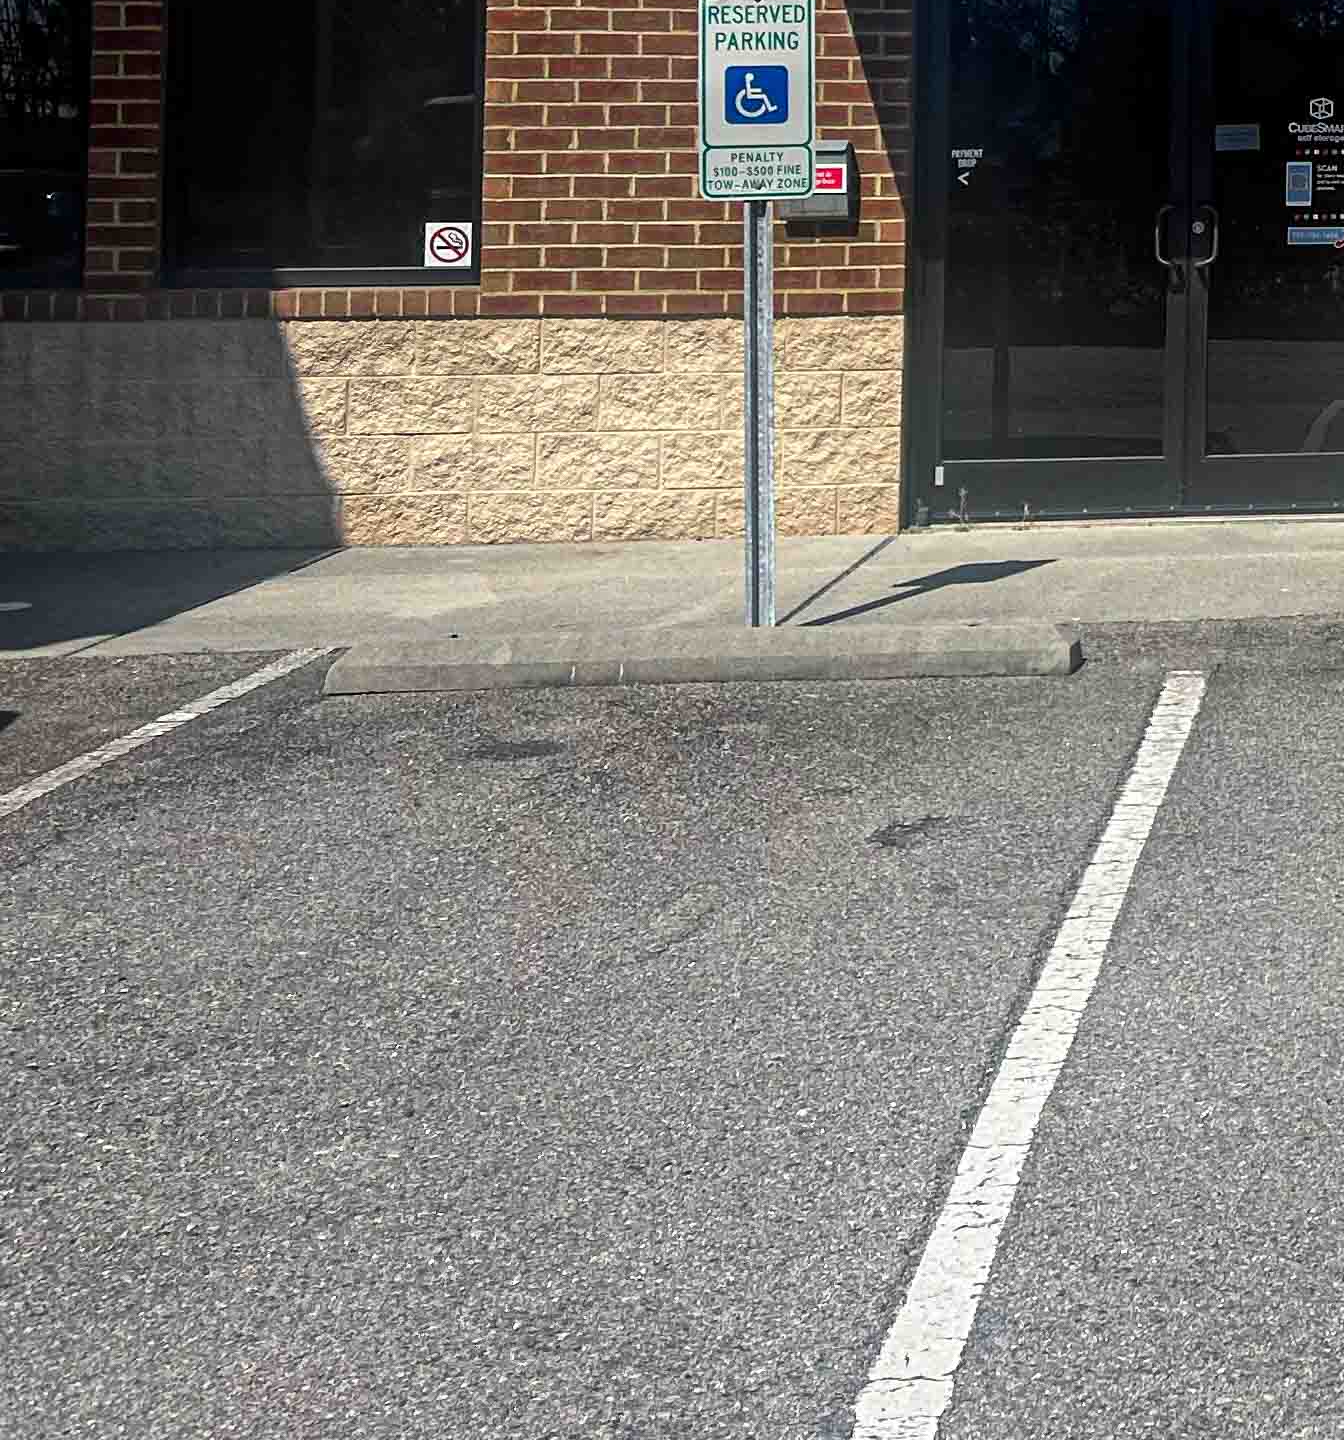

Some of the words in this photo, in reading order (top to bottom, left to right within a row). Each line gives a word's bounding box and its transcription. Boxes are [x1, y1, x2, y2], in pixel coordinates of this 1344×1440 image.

[708, 5, 805, 25] RESERVED
[715, 31, 799, 51] PARKING
[730, 152, 784, 163] PENALTY
[776, 164, 801, 175] FINE
[776, 178, 808, 189] ZONE
